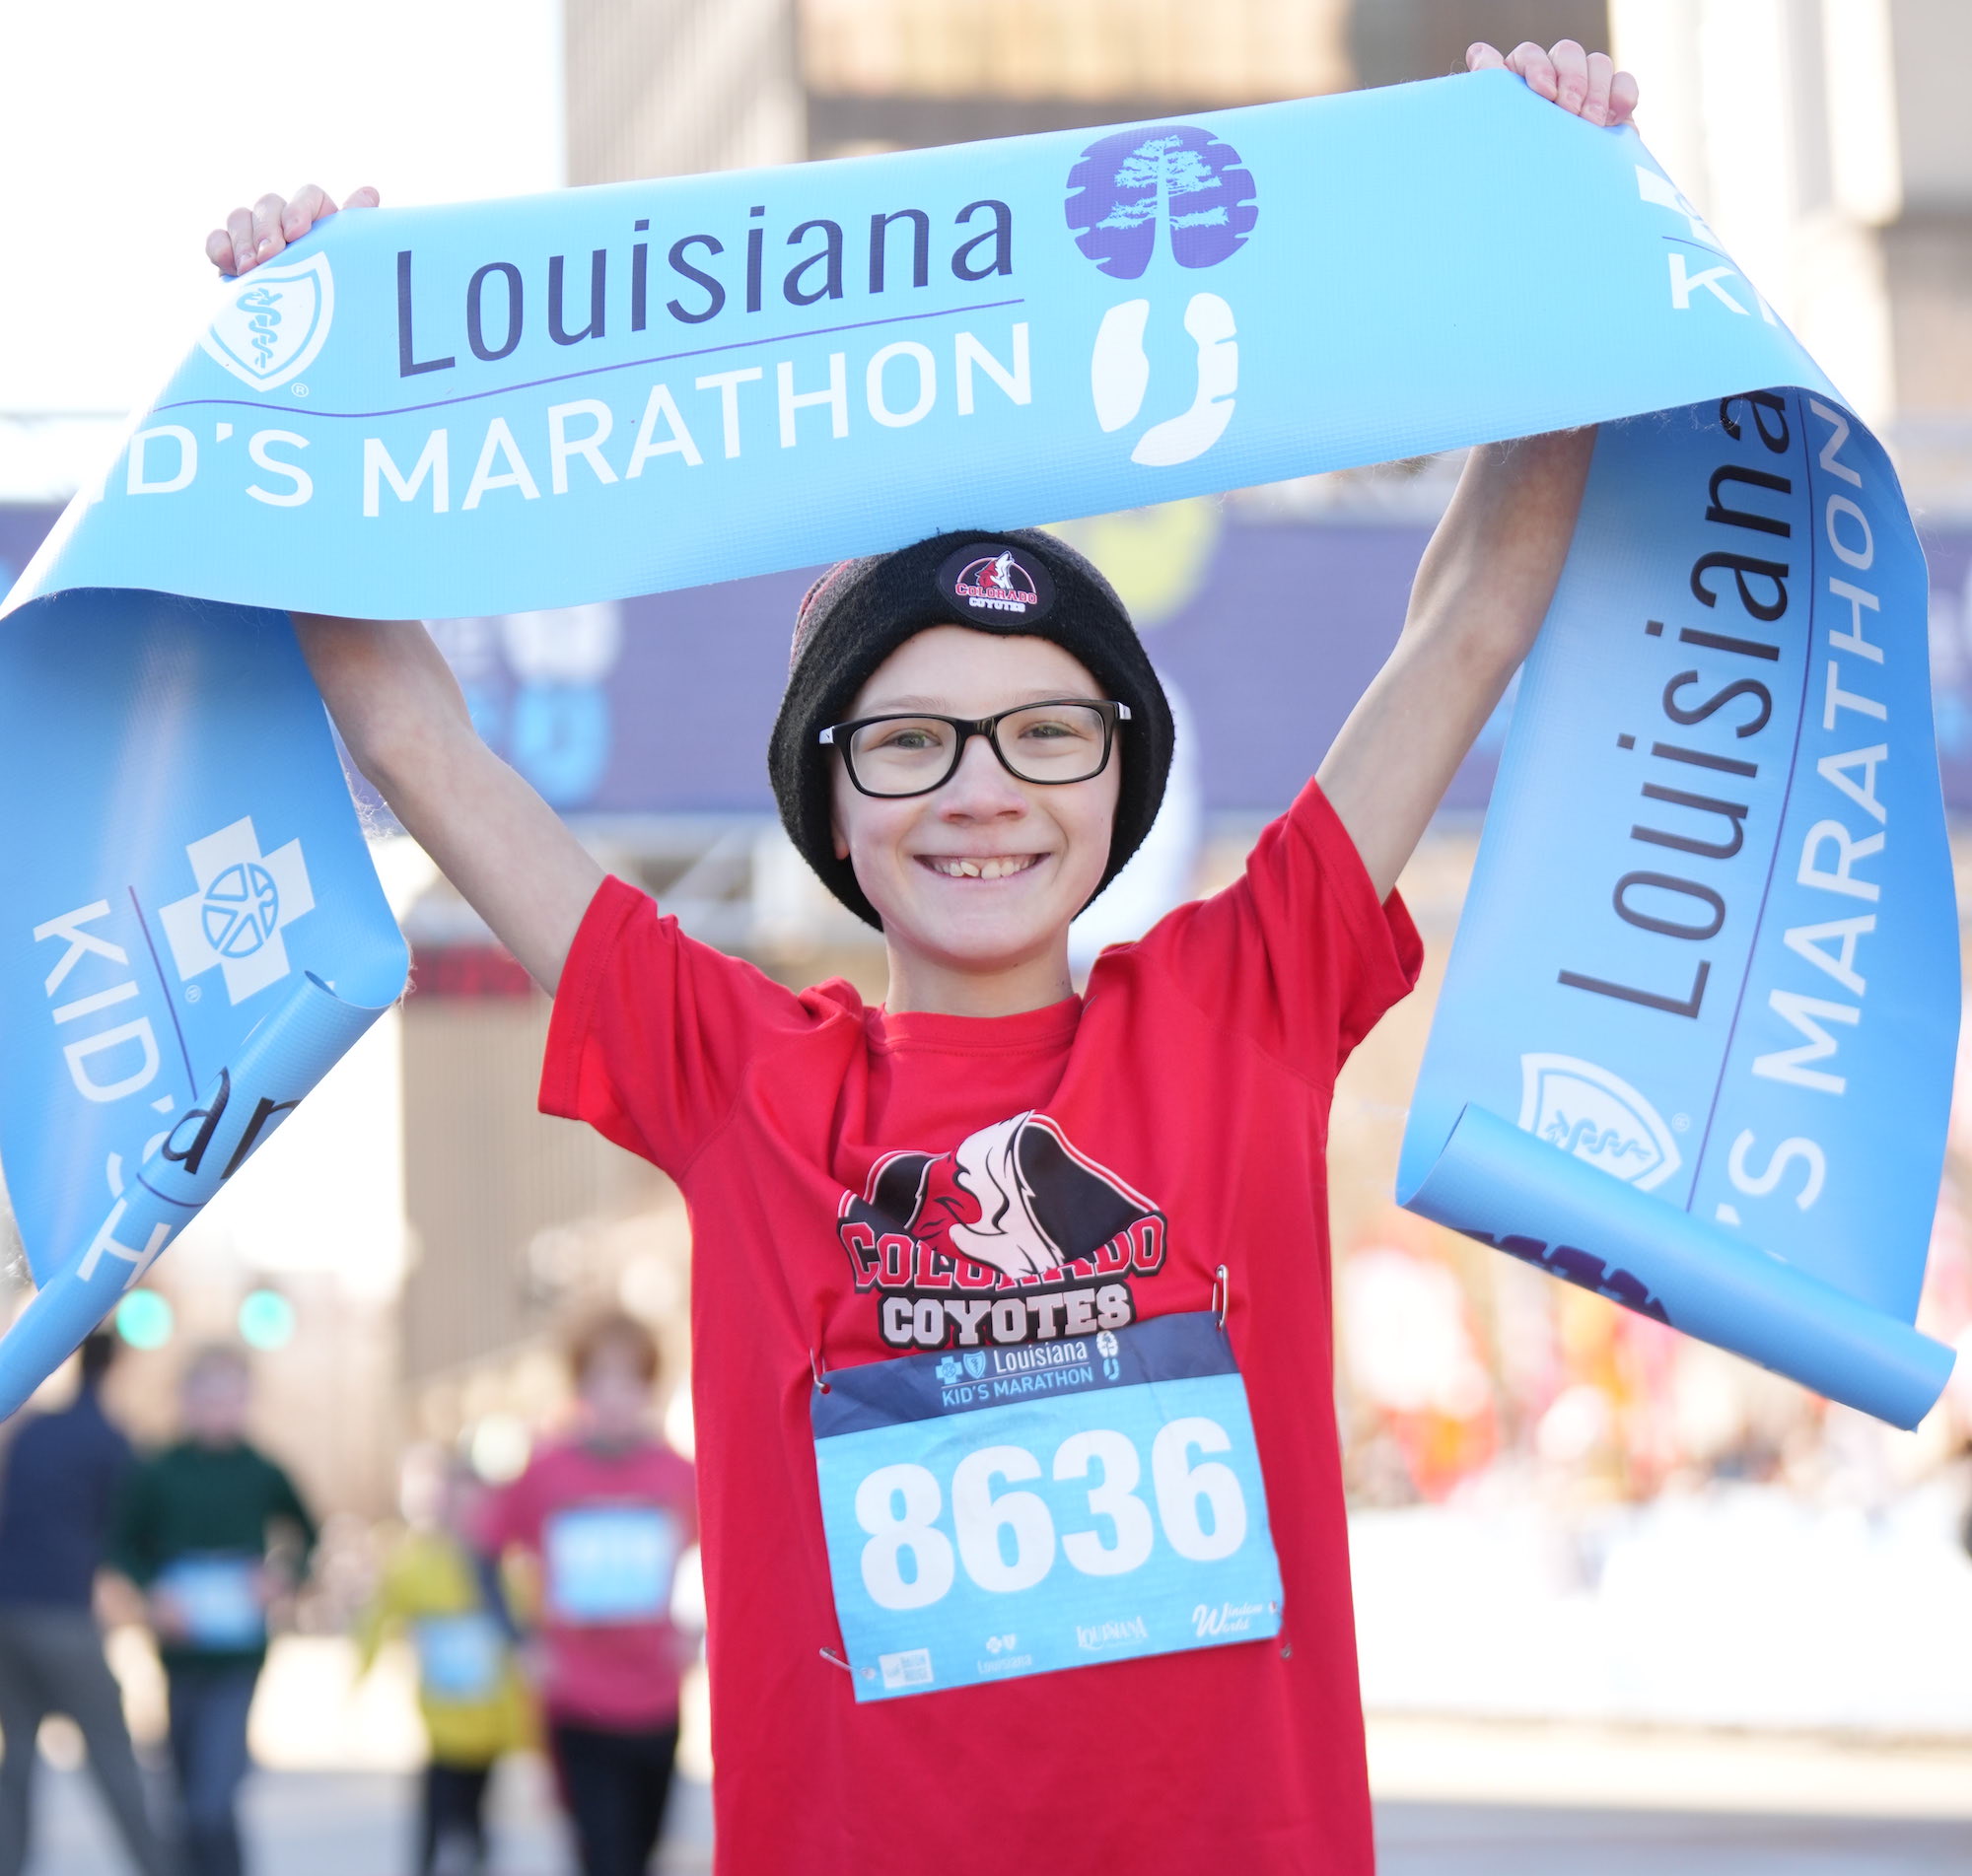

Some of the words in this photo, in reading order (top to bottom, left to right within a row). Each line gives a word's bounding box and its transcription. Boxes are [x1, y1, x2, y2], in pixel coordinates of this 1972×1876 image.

[397, 198, 1013, 379] Louisiana
[363, 321, 1033, 518] MARATHON
[954, 583, 1037, 604] COLORADO
[968, 596, 1025, 613] COYOTES
[1557, 389, 1792, 1019] Louisiana
[1751, 397, 1889, 1094] MARATHON
[839, 1215, 1165, 1291] COLODO
[881, 1283, 1132, 1346] COYOTES
[942, 1383, 990, 1408] KID'S
[993, 1365, 1094, 1398] MARATHON
[993, 1340, 1089, 1374] Louisiana
[854, 1417, 1248, 1611] 8636
